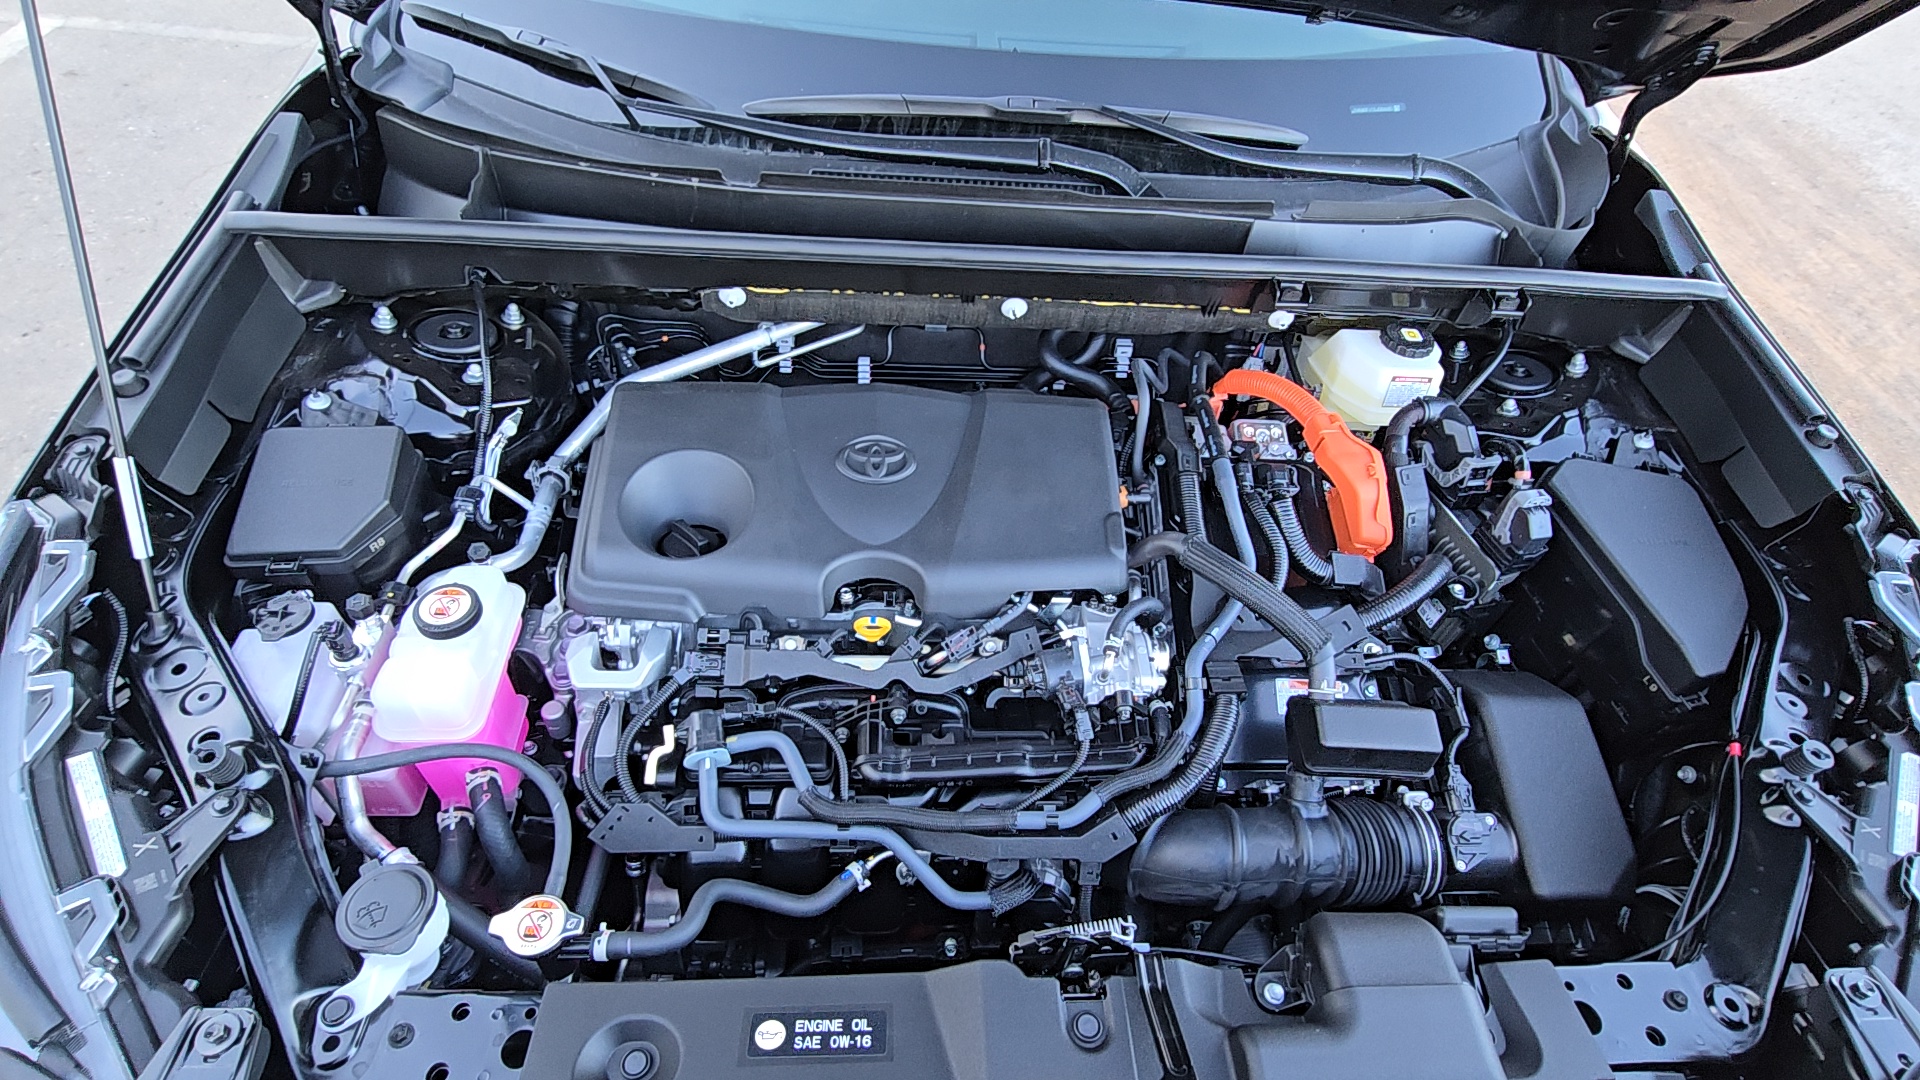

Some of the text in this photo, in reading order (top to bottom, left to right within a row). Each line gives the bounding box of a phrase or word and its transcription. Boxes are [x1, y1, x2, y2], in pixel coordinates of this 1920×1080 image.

[794, 1018, 873, 1033] ENGINE OIL
[793, 1035, 872, 1049] SAE 0W-16
